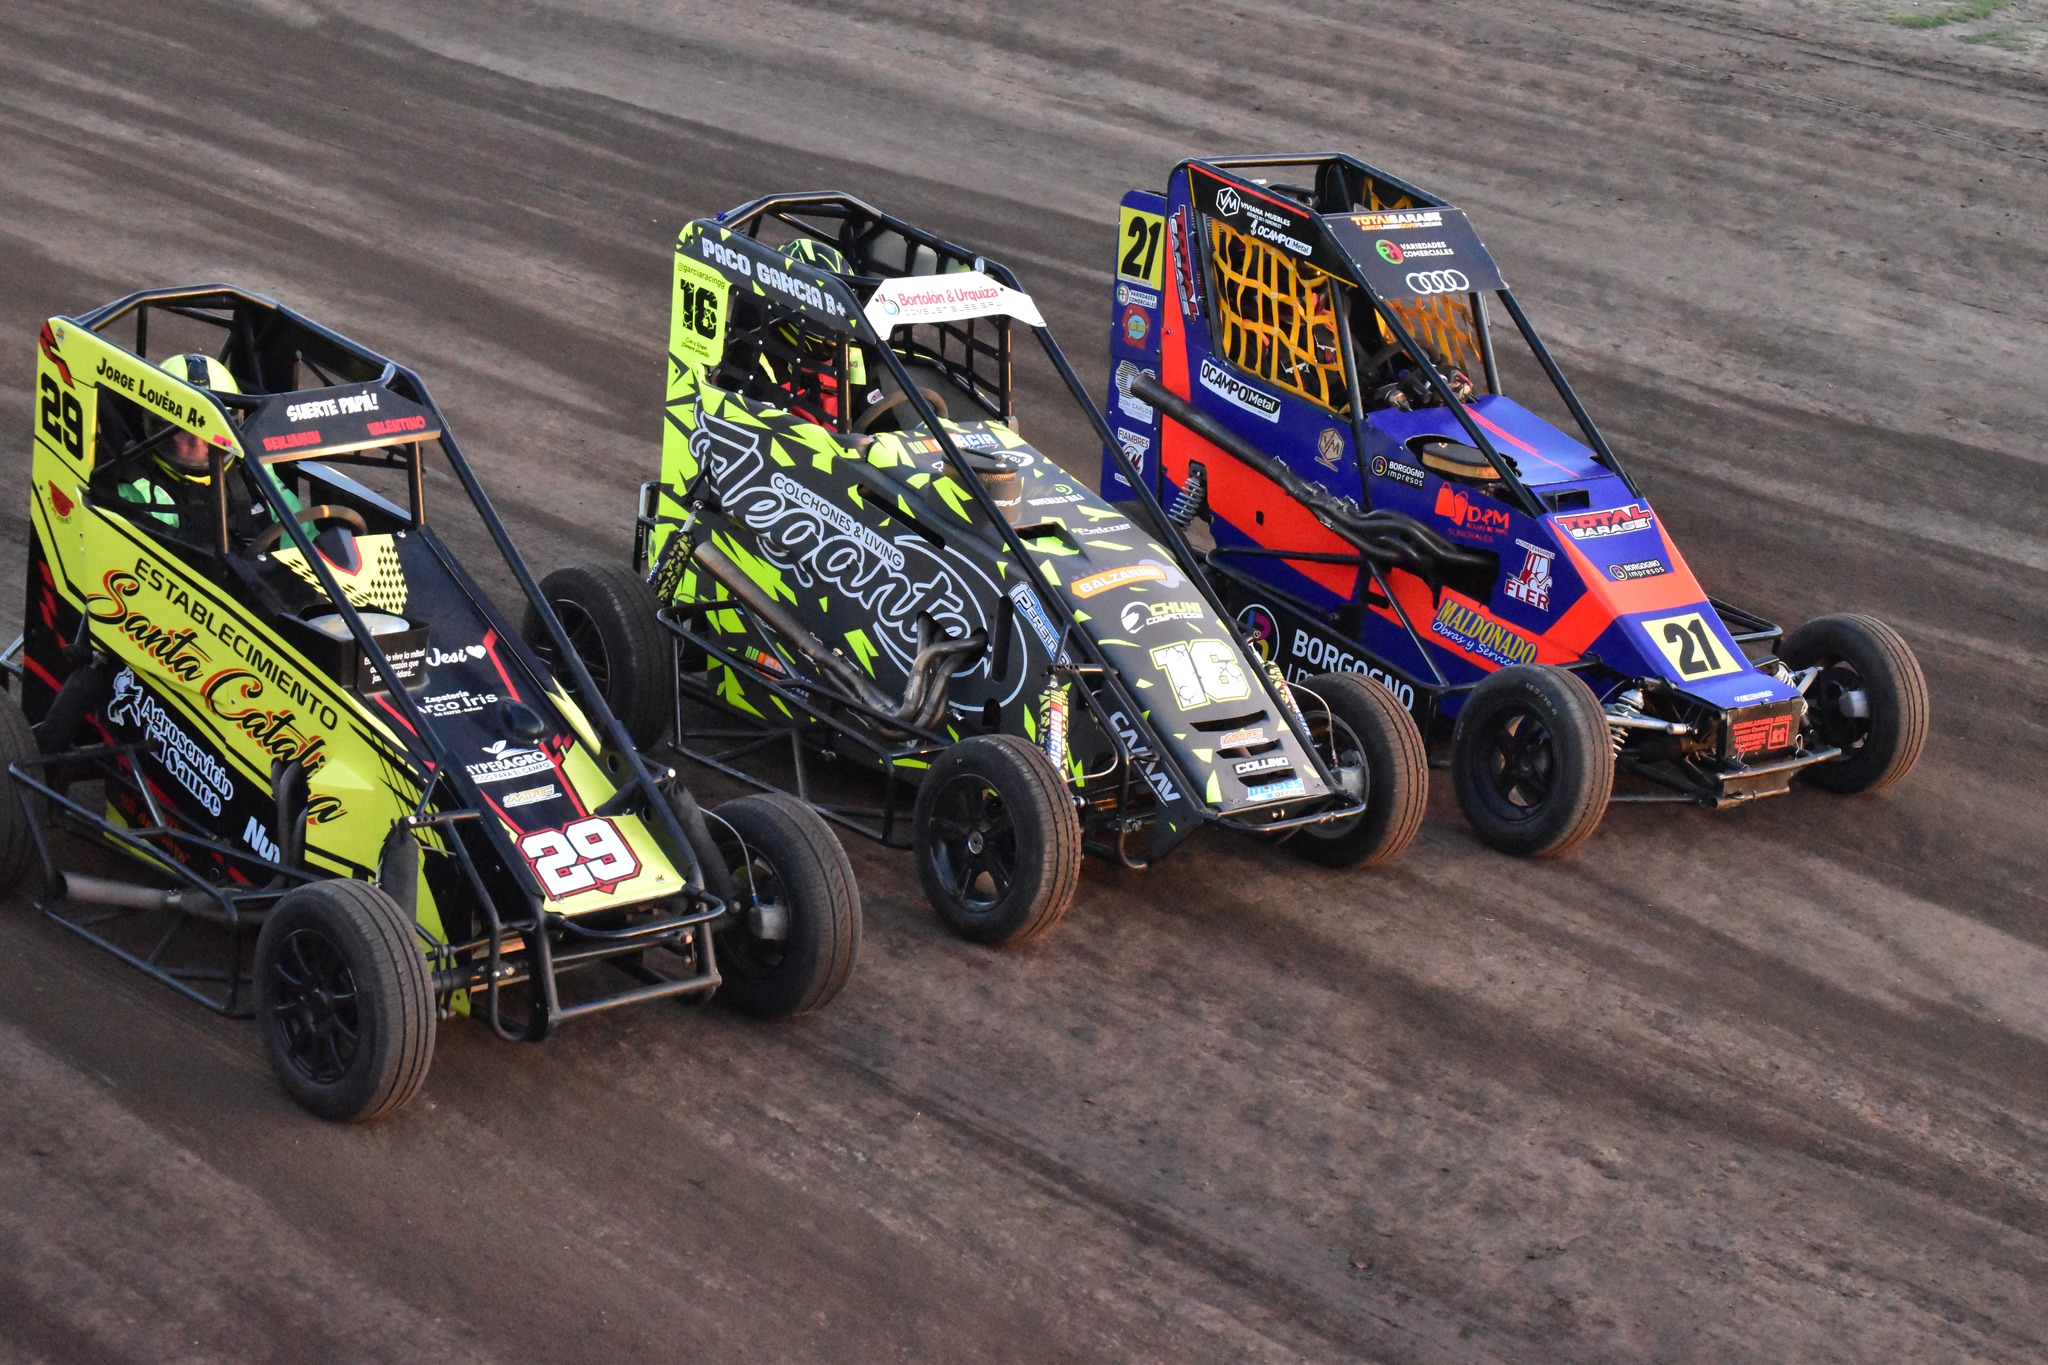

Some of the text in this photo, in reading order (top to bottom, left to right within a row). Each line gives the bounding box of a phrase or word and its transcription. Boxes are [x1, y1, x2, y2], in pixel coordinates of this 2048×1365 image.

[1240, 201, 1264, 216] VIVIANA
[1264, 211, 1291, 227] MUEBLES
[1121, 216, 1162, 280] 21
[1400, 241, 1447, 251] VARIEDADES
[1403, 248, 1455, 258] COMERCIALES
[701, 236, 752, 276] PACO
[756, 262, 824, 311] GARCIA
[946, 289, 956, 303] &
[953, 286, 999, 302] Urquiza
[1130, 290, 1156, 302] VARIEDADES
[680, 278, 718, 340] 16
[1202, 363, 1275, 412] OCAMPO Metal
[41, 372, 84, 461] 29
[187, 407, 206, 428] A+
[286, 390, 379, 423] SUERTE PAPÁ!
[366, 415, 426, 436] VALENTINO
[1118, 429, 1150, 449] FIAMBRES
[1387, 470, 1423, 487] impresos
[1388, 461, 1425, 479] BORGOGNO
[773, 476, 903, 569] COLCHONES & LIVING
[1557, 506, 1650, 530] TOTAL
[1571, 518, 1648, 538] GARAGE
[1624, 559, 1661, 572] BORGOGNO
[1628, 567, 1665, 578] impresos
[1078, 568, 1160, 594] BALZARINI
[1505, 581, 1550, 611] FLER
[1013, 589, 1059, 653] PERETT
[1149, 602, 1203, 617] CHUNI
[134, 557, 338, 731] ESTABLECIMIENTO
[1432, 621, 1517, 666] Obras y Servici
[1436, 599, 1537, 664] MALDONADO
[425, 647, 468, 667] Jesi
[1663, 618, 1722, 676] 21
[408, 660, 419, 671] que
[1151, 640, 1250, 711] 16
[87, 569, 348, 826] Santa Catala
[462, 693, 499, 707] Iris
[141, 695, 234, 801] Agroservicio
[493, 771, 512, 779] PARA
[521, 762, 550, 774] CAMPO
[1235, 756, 1289, 774] COLLINO
[165, 745, 221, 817] Sauce
[517, 815, 642, 900] 29
